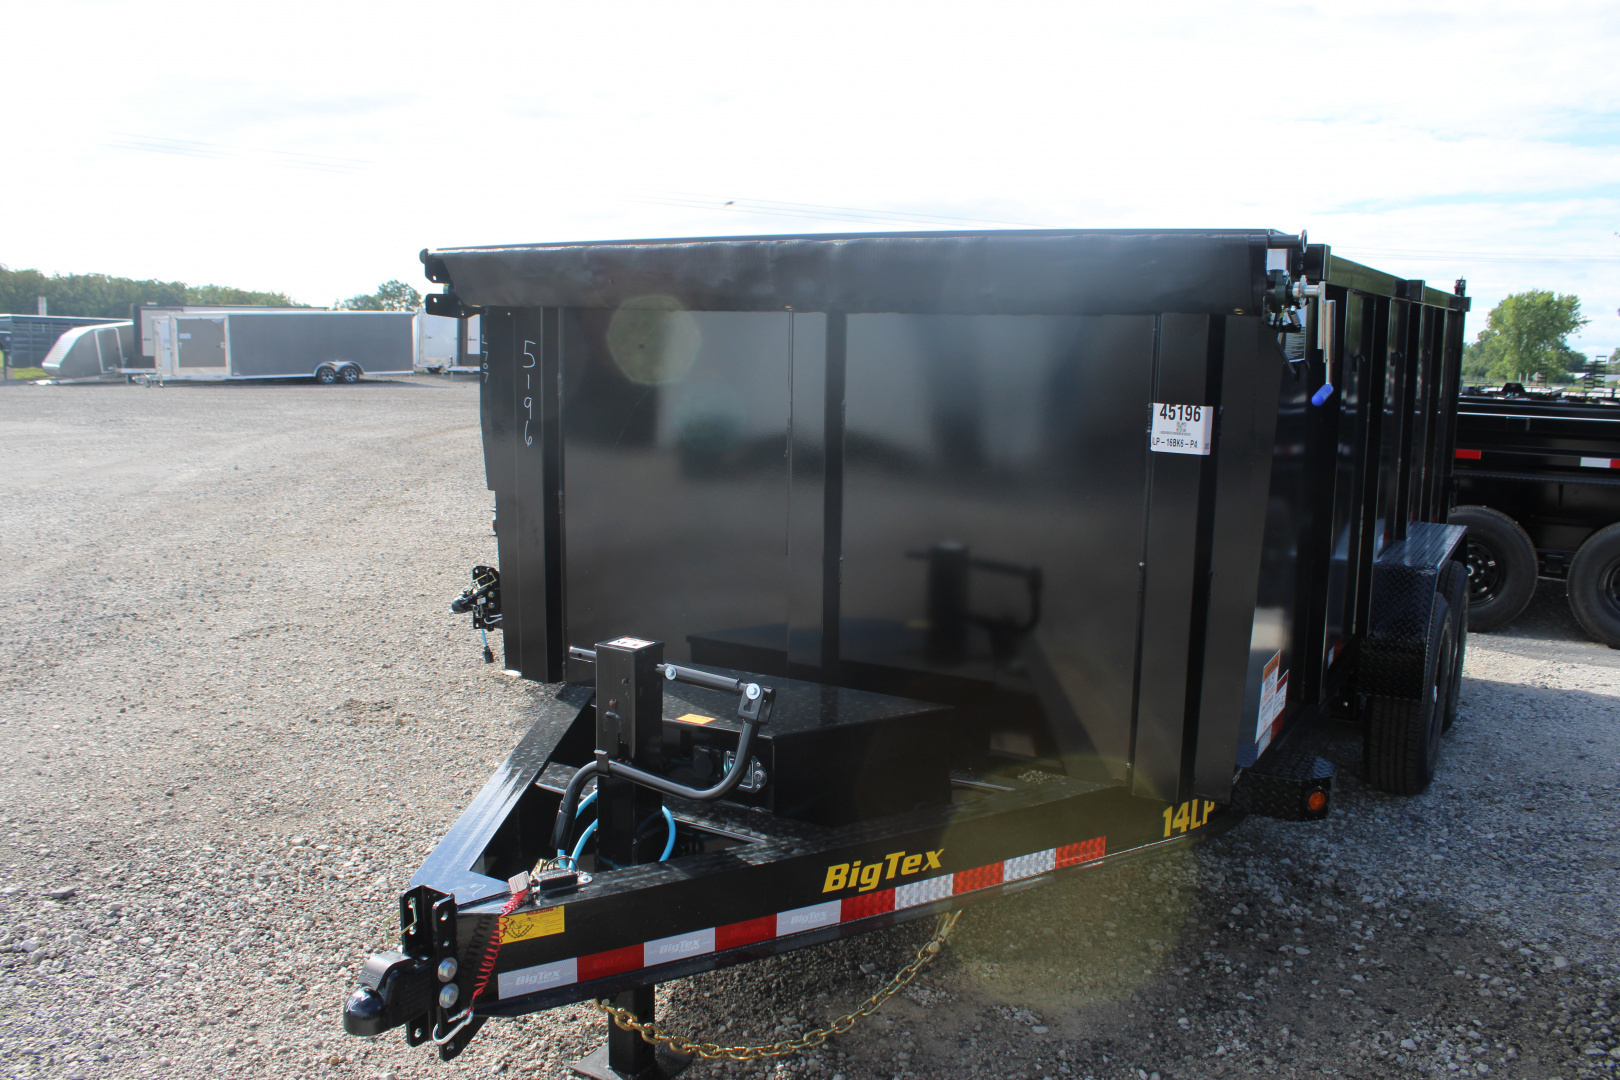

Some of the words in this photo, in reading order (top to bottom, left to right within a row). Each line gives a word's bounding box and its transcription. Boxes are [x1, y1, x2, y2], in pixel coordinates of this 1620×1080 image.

[1160, 403, 1201, 422] 45196
[822, 849, 945, 893] BigTex
[790, 911, 827, 925] BigTex
[659, 939, 701, 955] BigTex
[516, 970, 561, 986] BigTex
